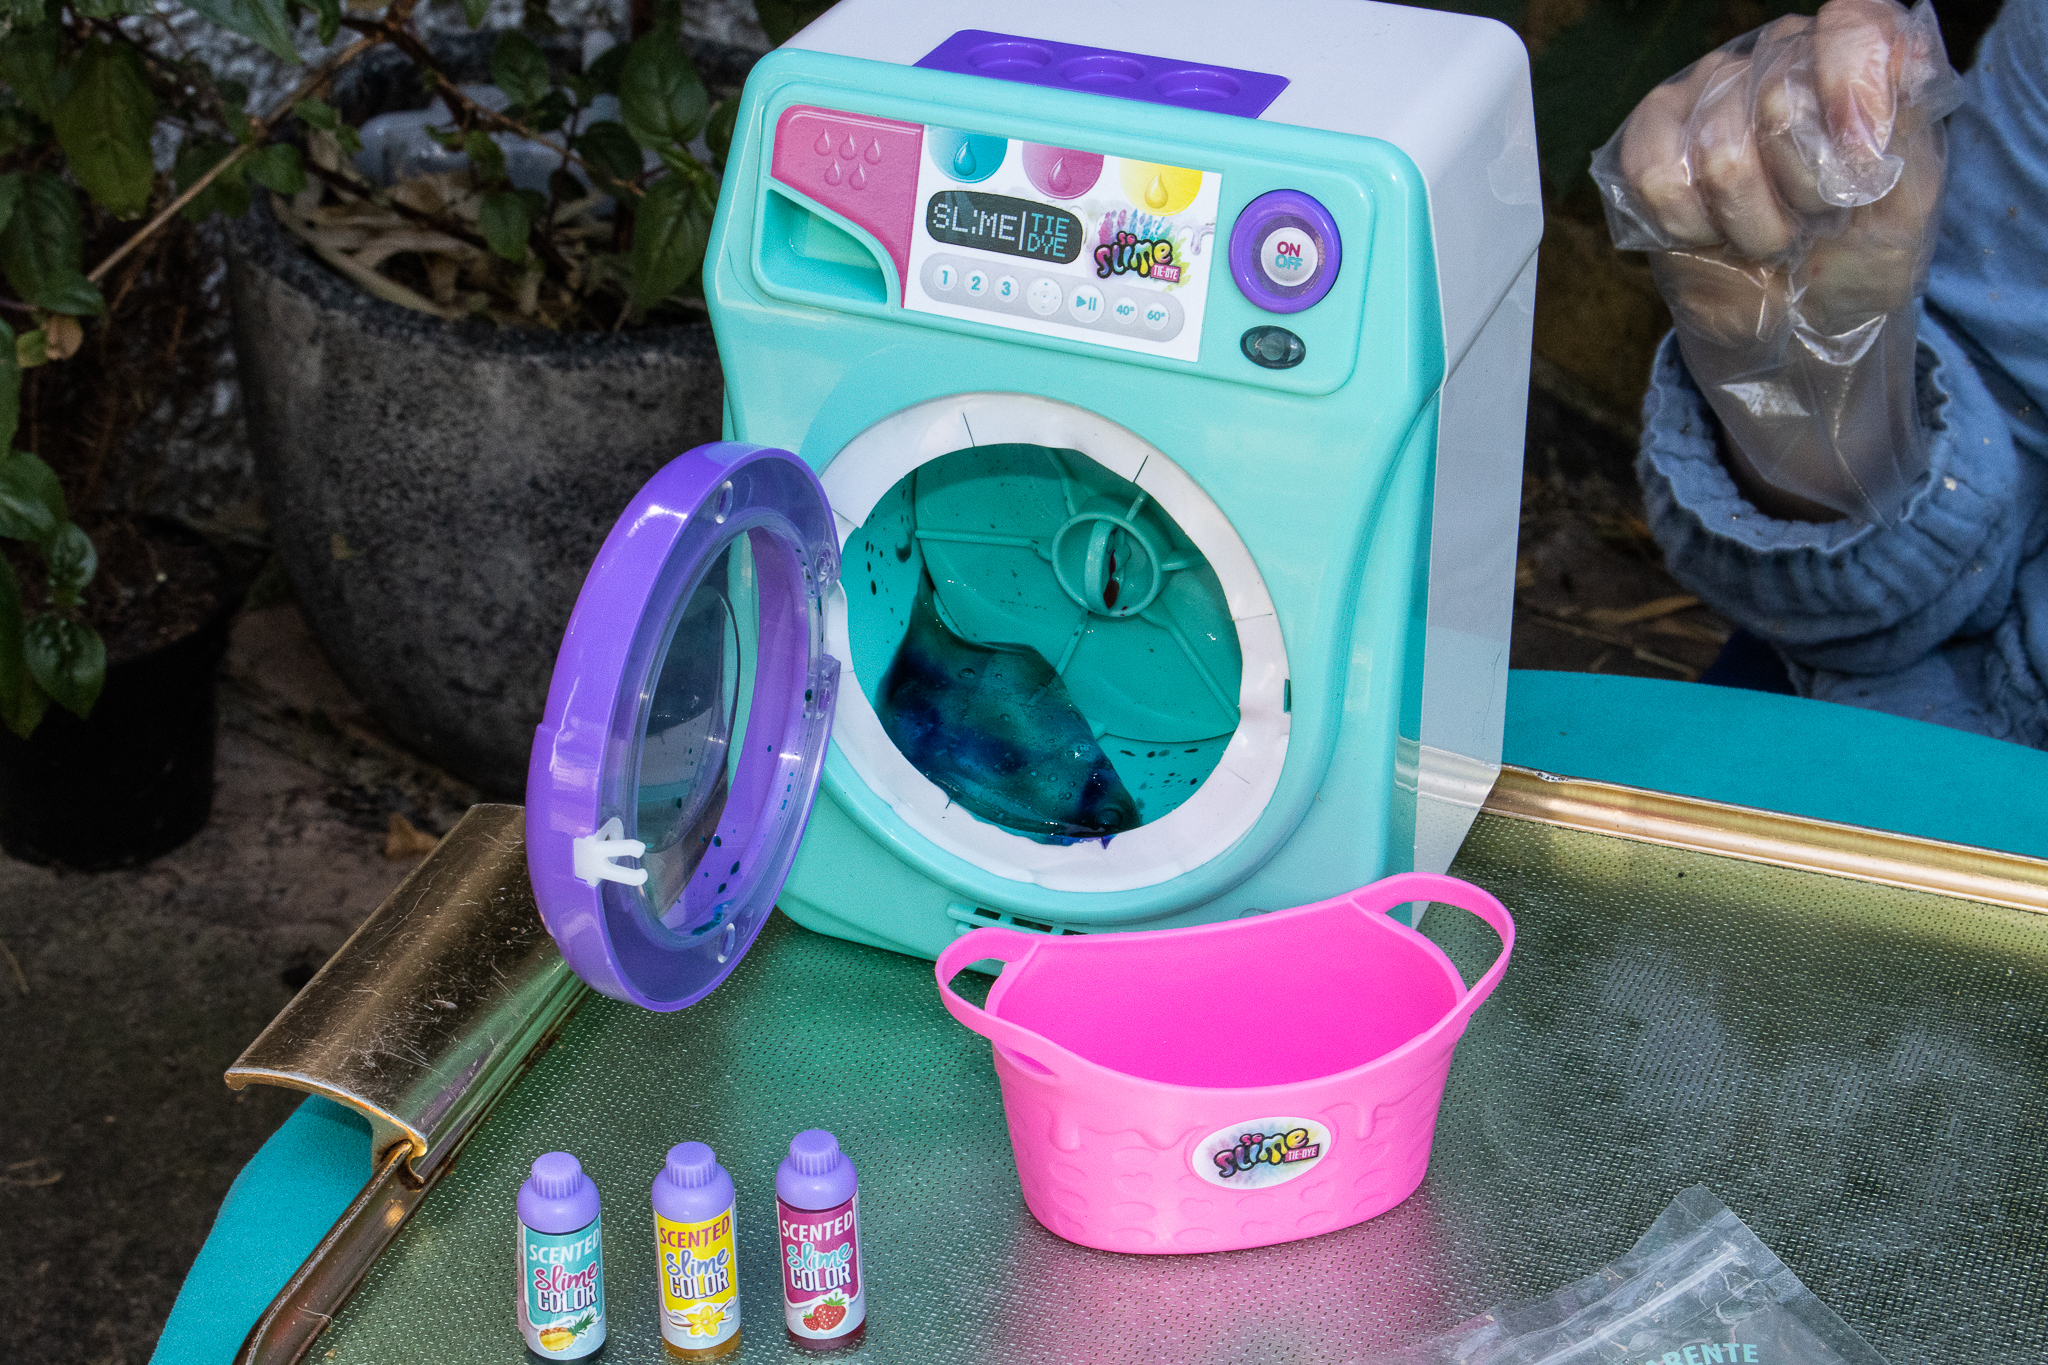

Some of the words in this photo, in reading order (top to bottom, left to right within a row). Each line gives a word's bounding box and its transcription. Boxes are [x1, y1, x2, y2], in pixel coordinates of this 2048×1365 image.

[1031, 212, 1070, 237] TIE
[1027, 233, 1067, 258] DYE
[1277, 241, 1301, 257] ON
[1153, 264, 1179, 280] TIE-DYE
[1275, 254, 1303, 271] OFF
[942, 270, 948, 285] 1
[971, 276, 981, 291] 2
[1001, 281, 1011, 296] 3
[1288, 1146, 1316, 1161] TIE-DYE
[660, 1216, 730, 1248] SCENTED
[782, 1211, 853, 1242] SCENTED
[529, 1228, 600, 1264] SCENTED
[787, 1242, 853, 1271] Slime
[665, 1247, 730, 1278] Slime
[534, 1261, 599, 1293] Slime
[669, 1267, 730, 1300] COLOR
[791, 1263, 852, 1292] COLOR
[538, 1281, 598, 1314] COLOR
